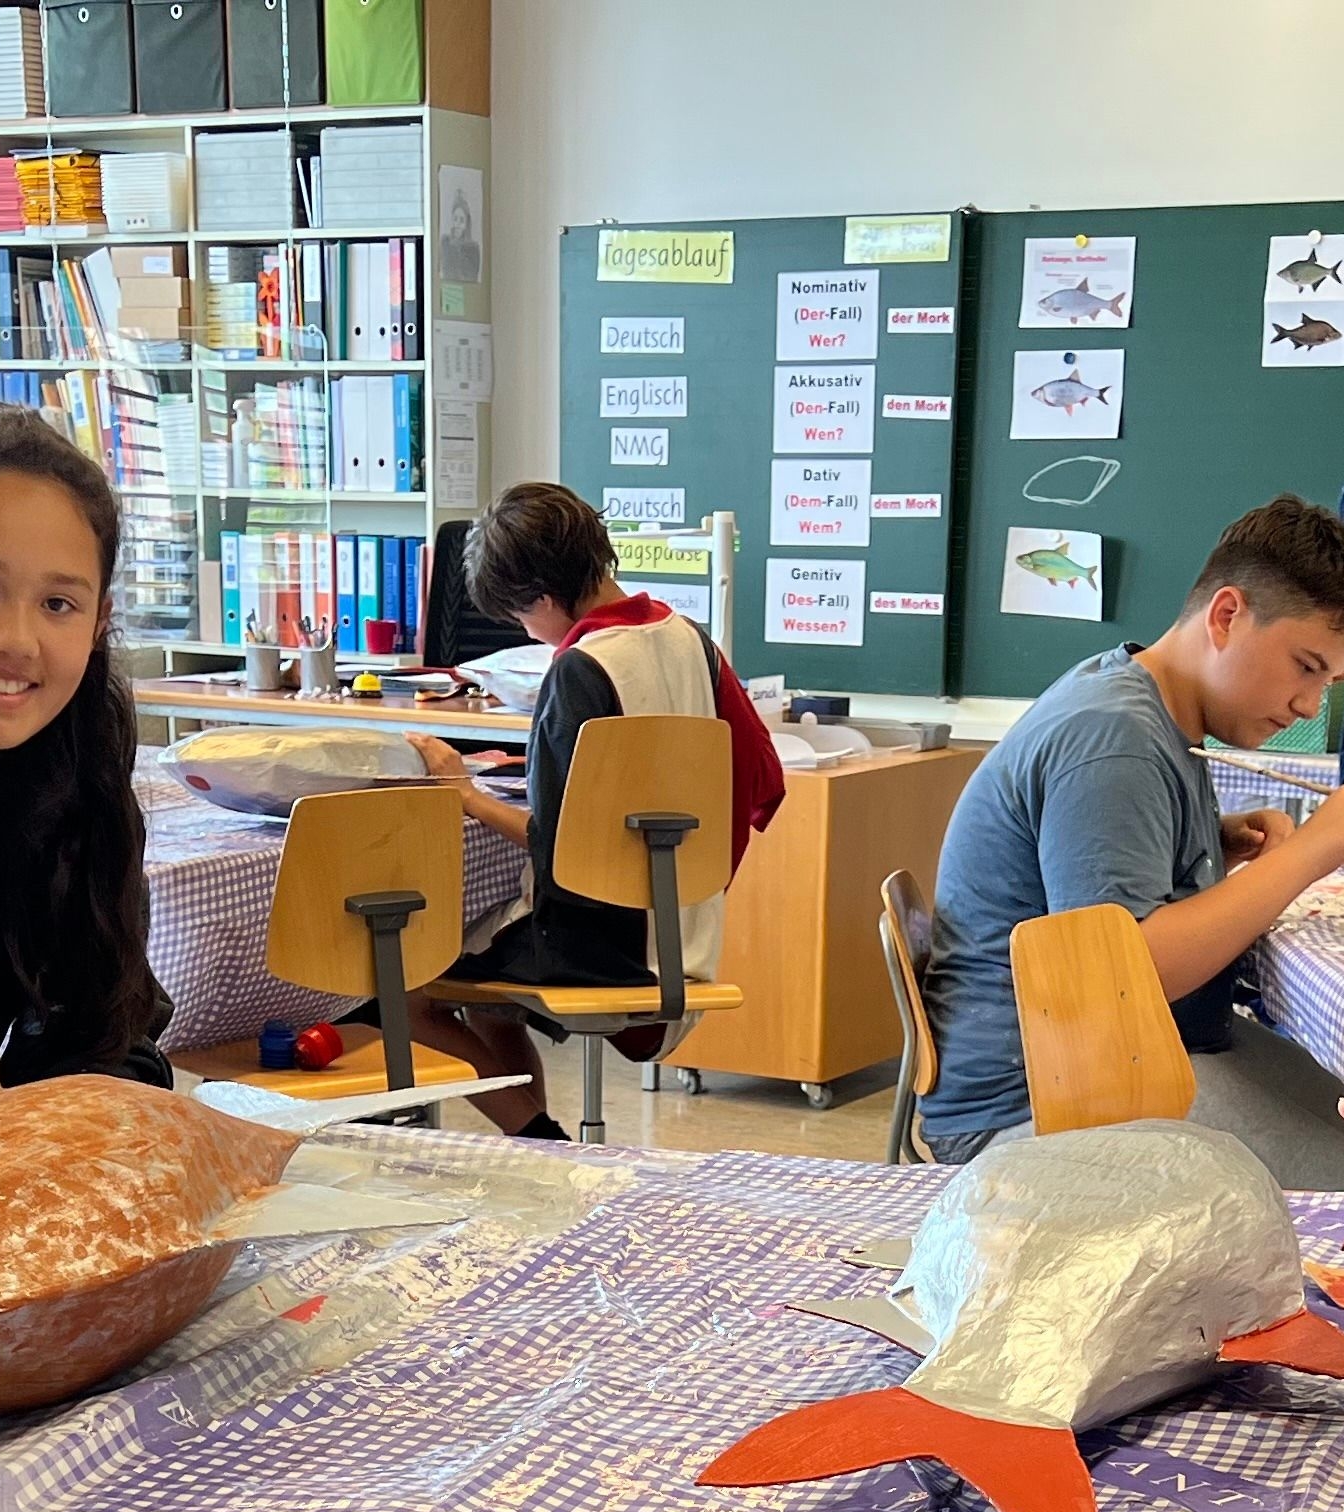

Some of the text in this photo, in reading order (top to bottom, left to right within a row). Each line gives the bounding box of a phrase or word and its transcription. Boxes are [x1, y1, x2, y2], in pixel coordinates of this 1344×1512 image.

[604, 238, 730, 278] Tagesablauf
[791, 278, 867, 294] Nominativ
[794, 306, 862, 324] (Der-Fall)
[891, 311, 950, 324] der Mork
[606, 321, 681, 349] Deutsch
[809, 333, 846, 347] Wer?
[788, 374, 863, 388] Akkusativ
[606, 379, 684, 415] Englisch
[790, 401, 860, 418] (Den-Fall)
[887, 399, 948, 412] den Mork
[804, 427, 844, 441] Wen?
[614, 435, 664, 465] NMG
[803, 468, 841, 482] Dativ
[608, 492, 682, 518] Deutsch
[784, 495, 858, 511] (Dem-Fall)
[874, 498, 938, 510] dem Mork
[798, 521, 843, 534] Wem?
[791, 567, 843, 581] Genitiv
[782, 592, 850, 610] (Des-Fall)
[874, 597, 940, 611] des Morks
[783, 618, 847, 633] Wessen?
